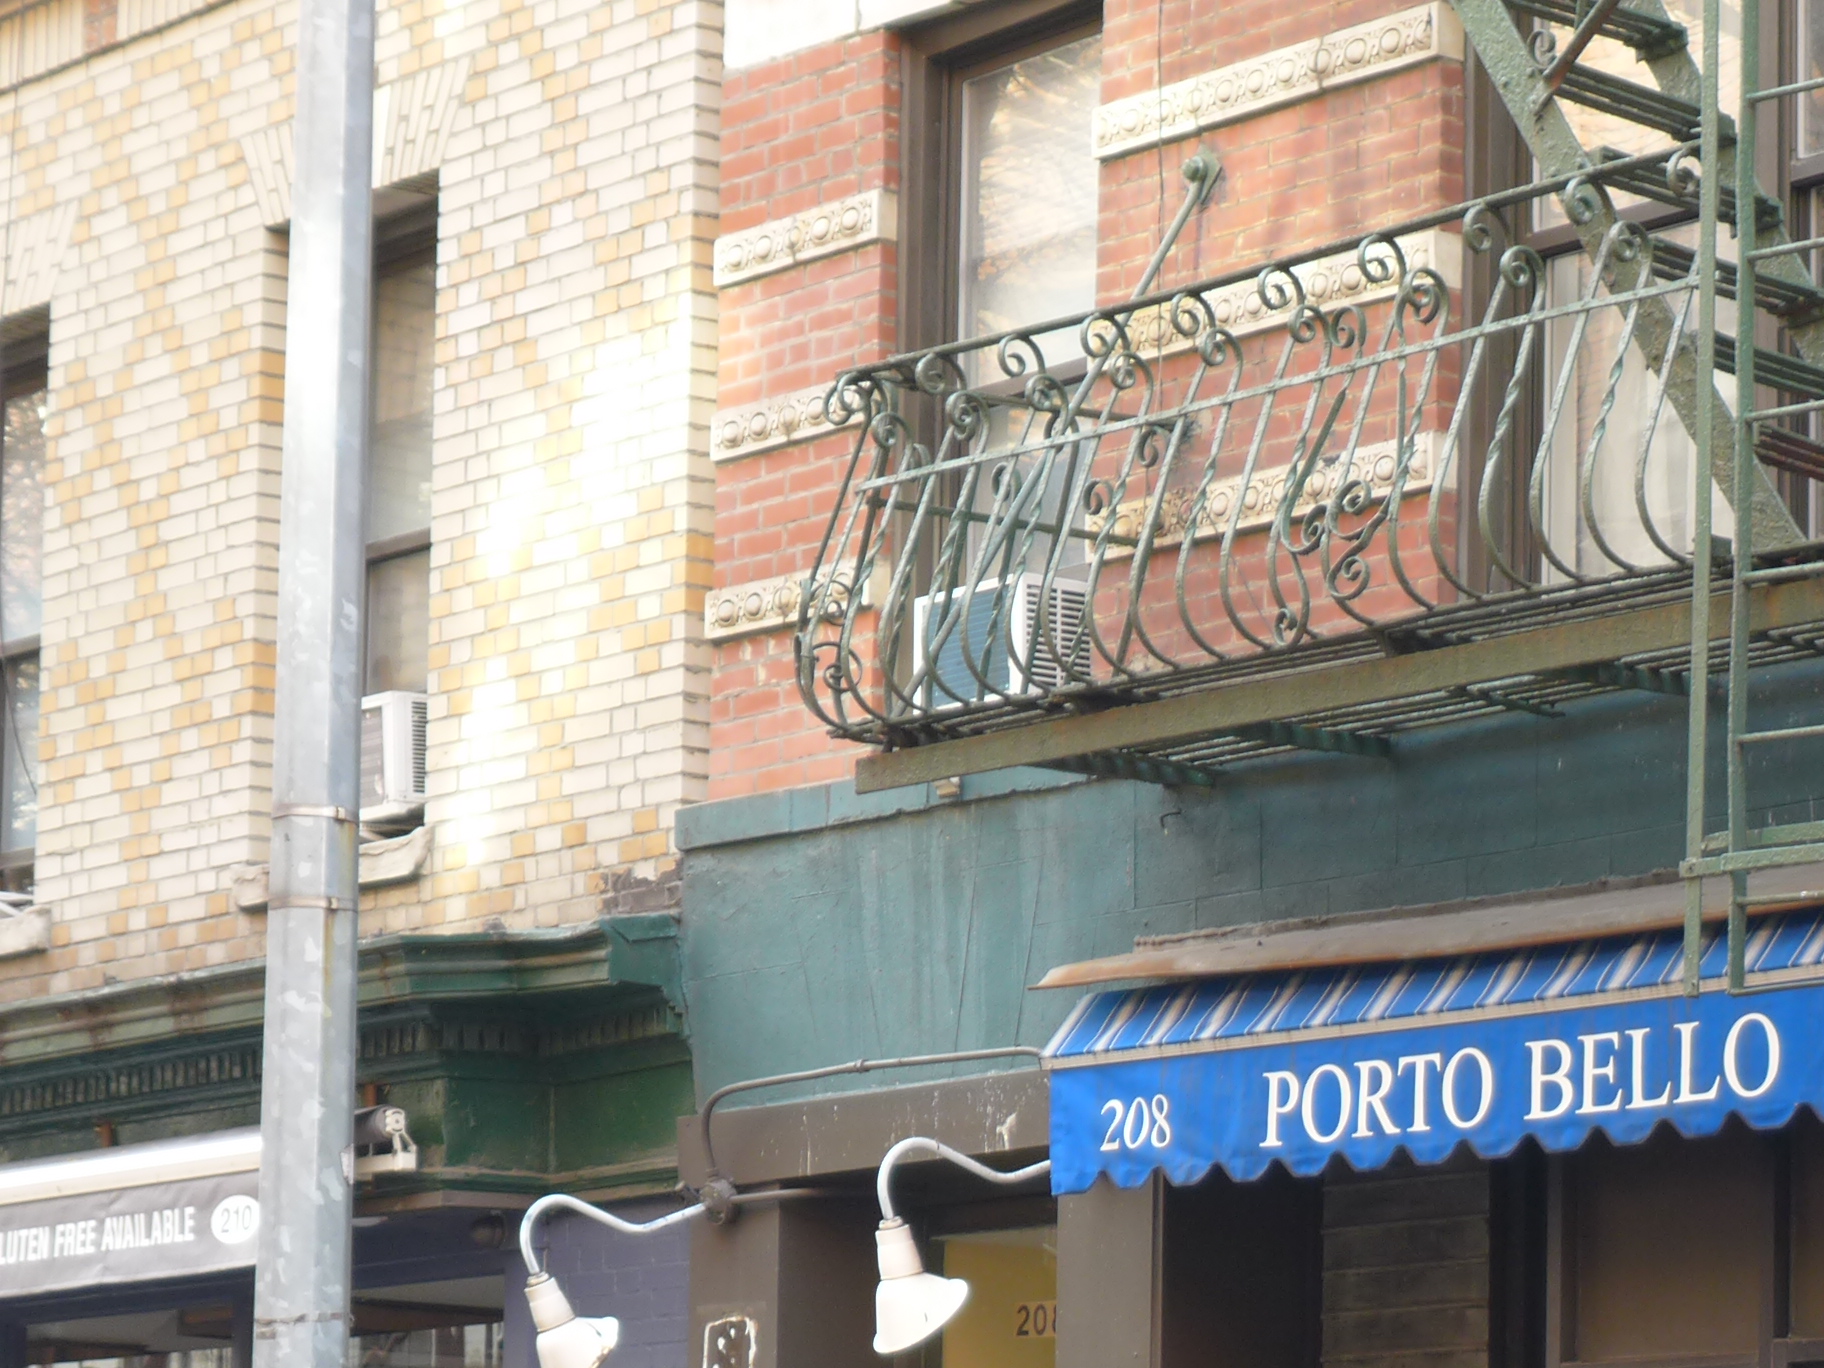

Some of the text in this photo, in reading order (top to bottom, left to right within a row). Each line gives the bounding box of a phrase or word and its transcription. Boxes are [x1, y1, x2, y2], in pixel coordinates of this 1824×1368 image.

[1259, 1011, 1782, 1148] PORTO BELLO
[1100, 1093, 1172, 1153] 208
[53, 1220, 97, 1258] FREE
[101, 1206, 195, 1251] AVAILABLE
[221, 1205, 253, 1234] 210
[1016, 1304, 1056, 1336] 20
